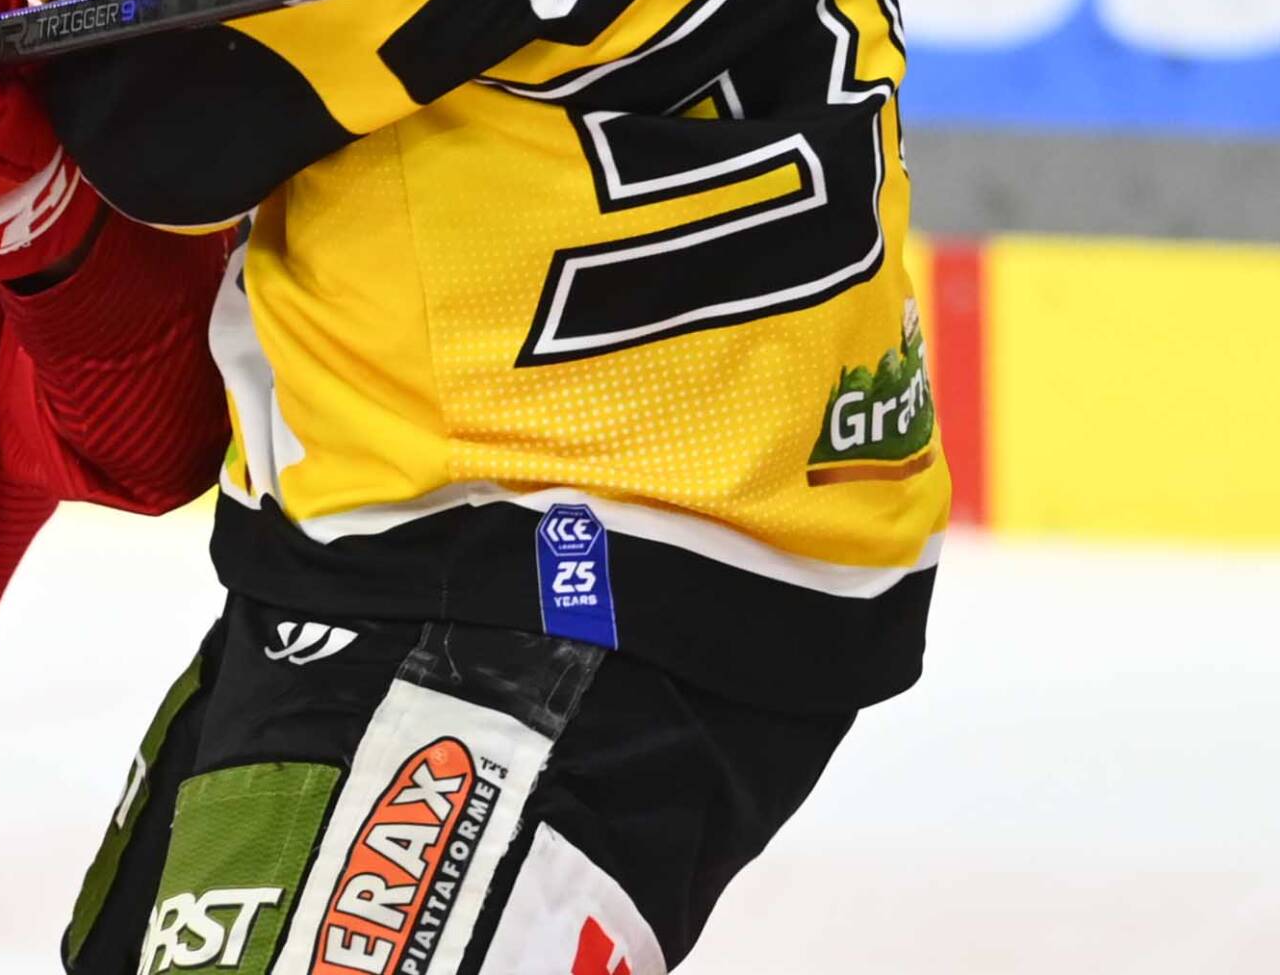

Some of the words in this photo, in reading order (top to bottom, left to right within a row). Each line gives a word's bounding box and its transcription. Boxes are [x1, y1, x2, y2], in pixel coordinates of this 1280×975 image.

[830, 366, 926, 452] Gran
[546, 517, 592, 542] ICE
[552, 561, 596, 593] 25
[554, 594, 598, 607] YEARS
[401, 781, 495, 974] PIATTAFORME
[136, 887, 284, 974] RST
